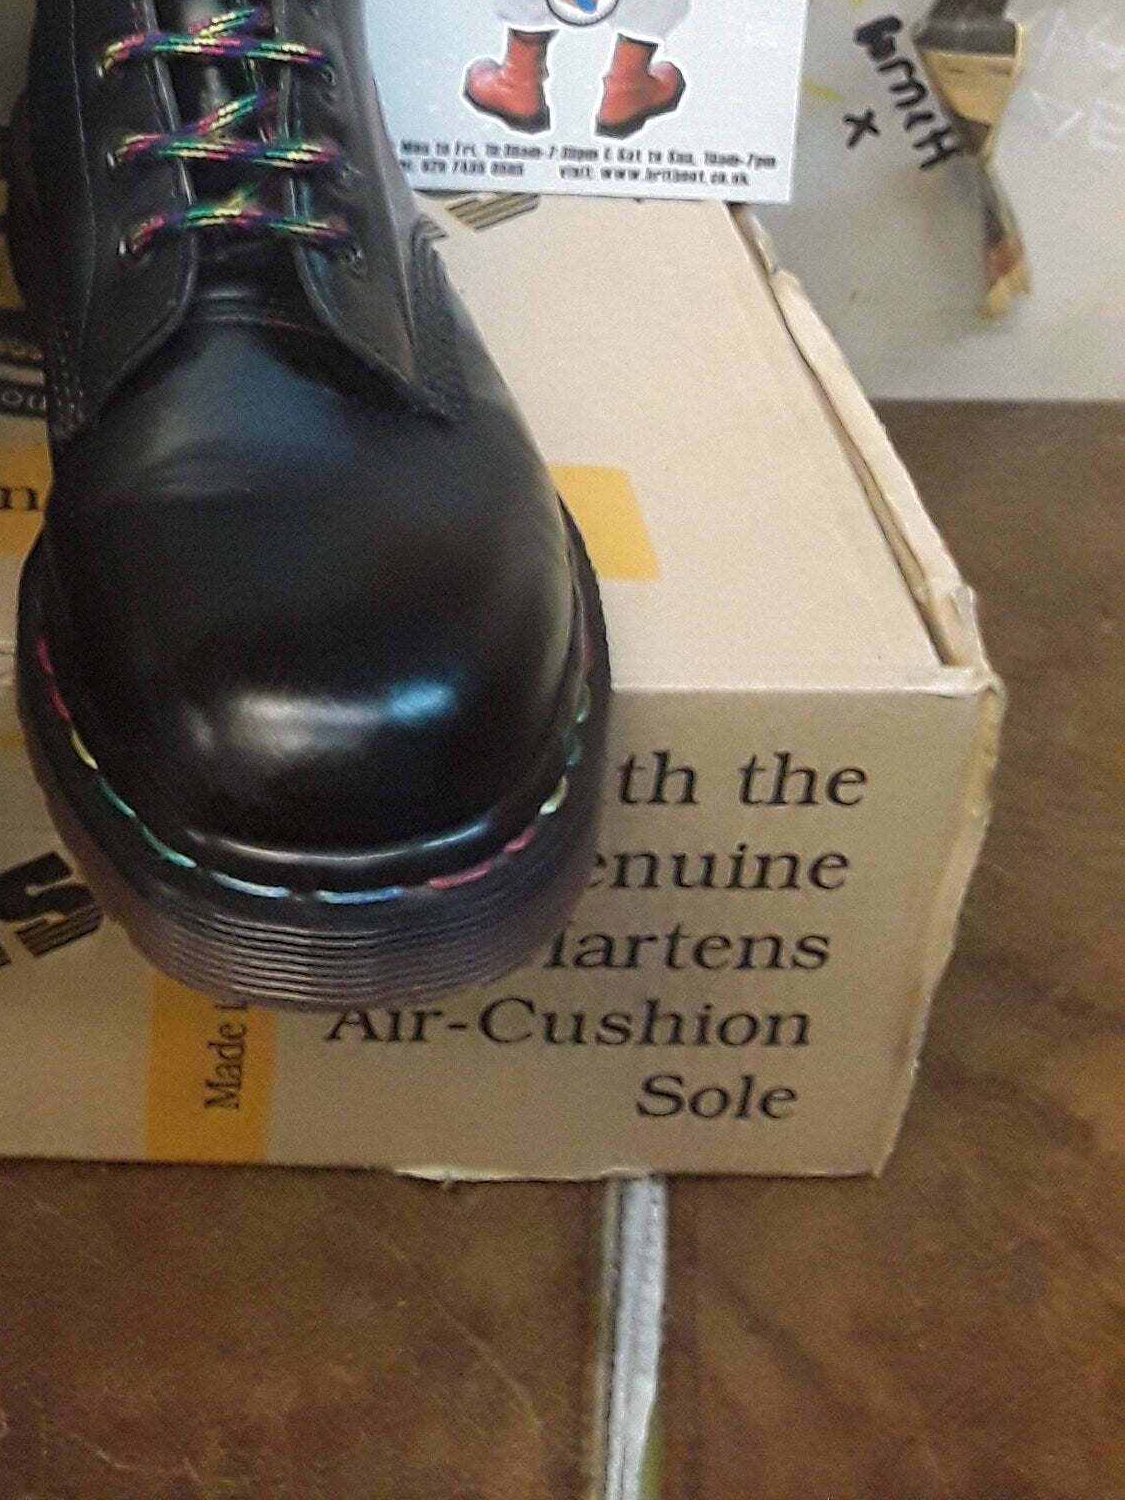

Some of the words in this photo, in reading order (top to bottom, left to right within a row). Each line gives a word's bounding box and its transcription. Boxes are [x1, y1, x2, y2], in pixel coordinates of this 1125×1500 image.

[737, 750, 869, 808] the
[325, 997, 812, 1047] Air-Cushion
[203, 1021, 248, 1111] Made
[635, 1073, 800, 1120] Sole
